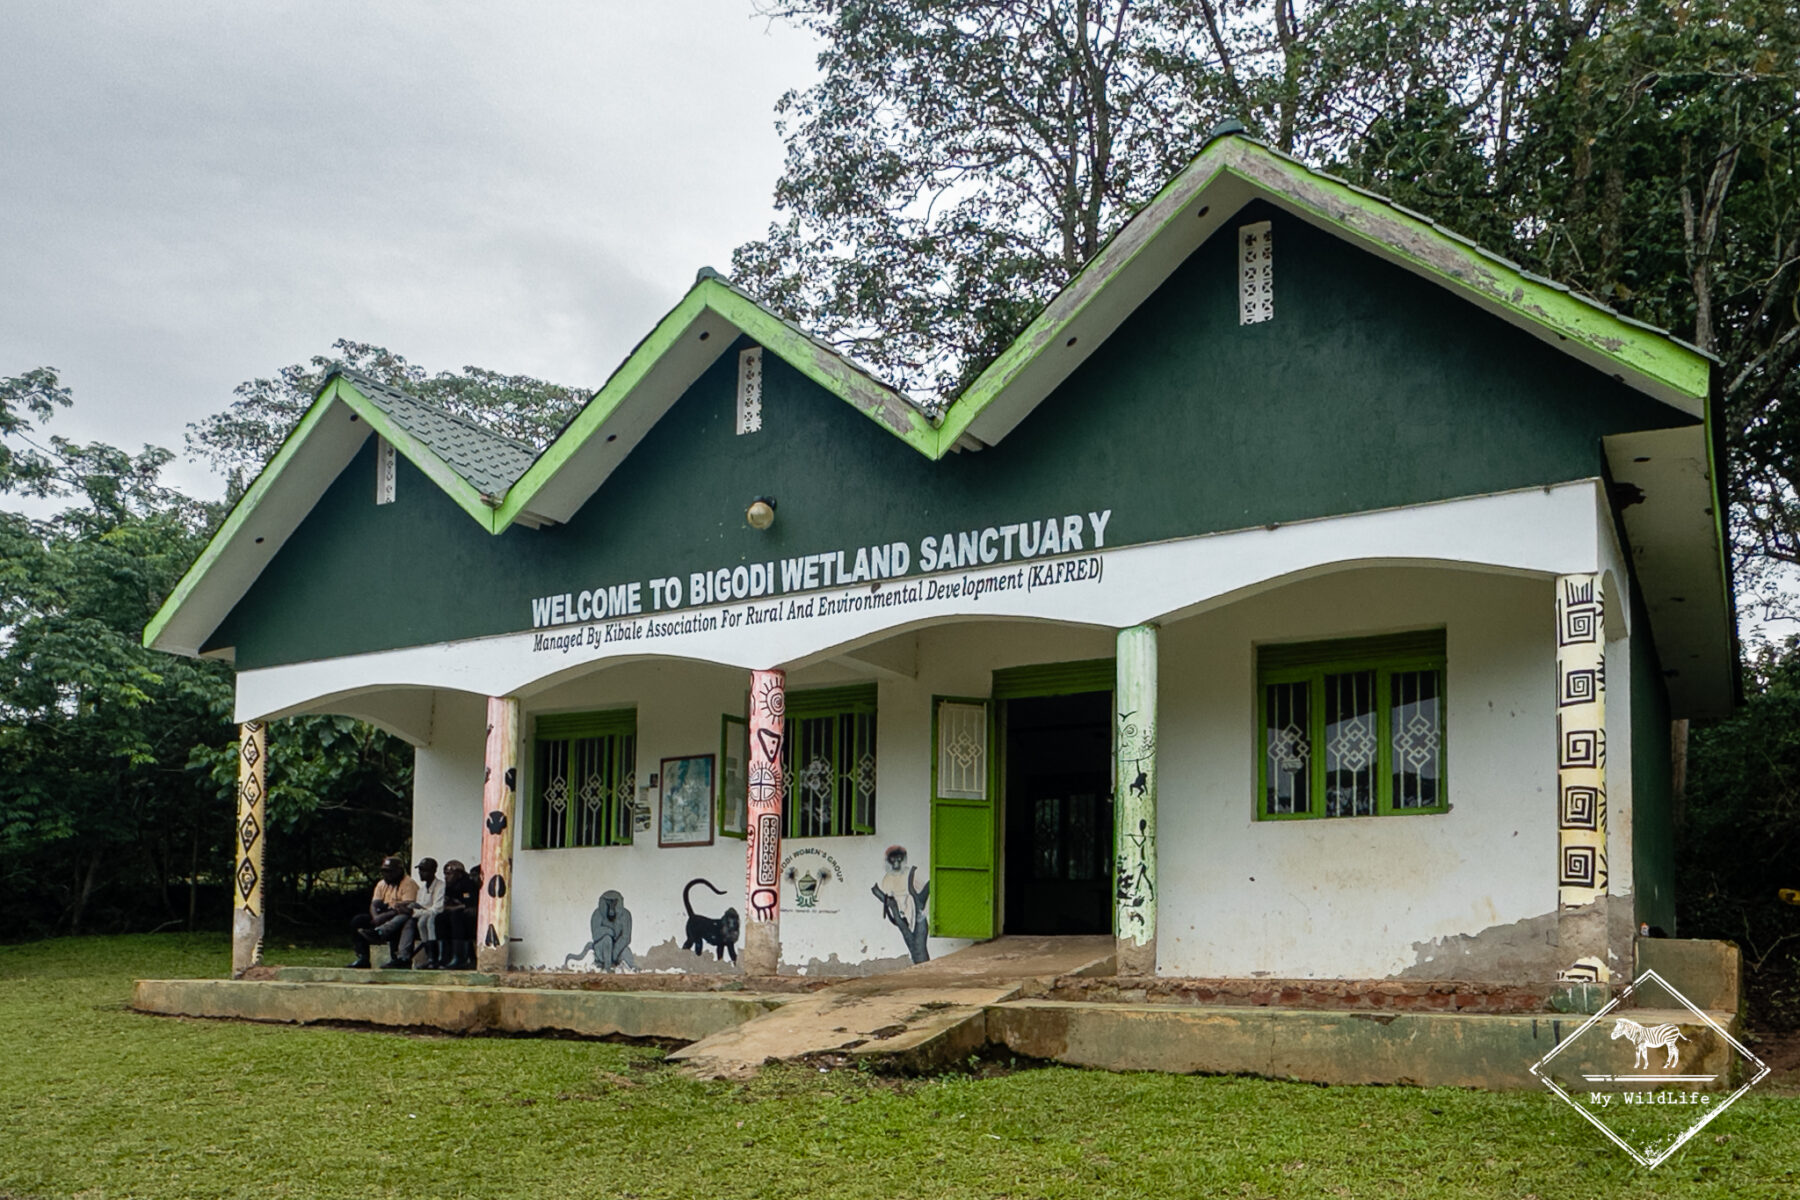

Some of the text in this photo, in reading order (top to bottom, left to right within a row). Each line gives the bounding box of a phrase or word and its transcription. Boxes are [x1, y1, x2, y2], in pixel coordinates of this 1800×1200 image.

[532, 509, 1112, 628] WELCOME TO BIGODI WETLAND SANCTUARY
[533, 556, 1104, 654] Managed By Kibale Association For Rural And Environmental Development (KAFRED)
